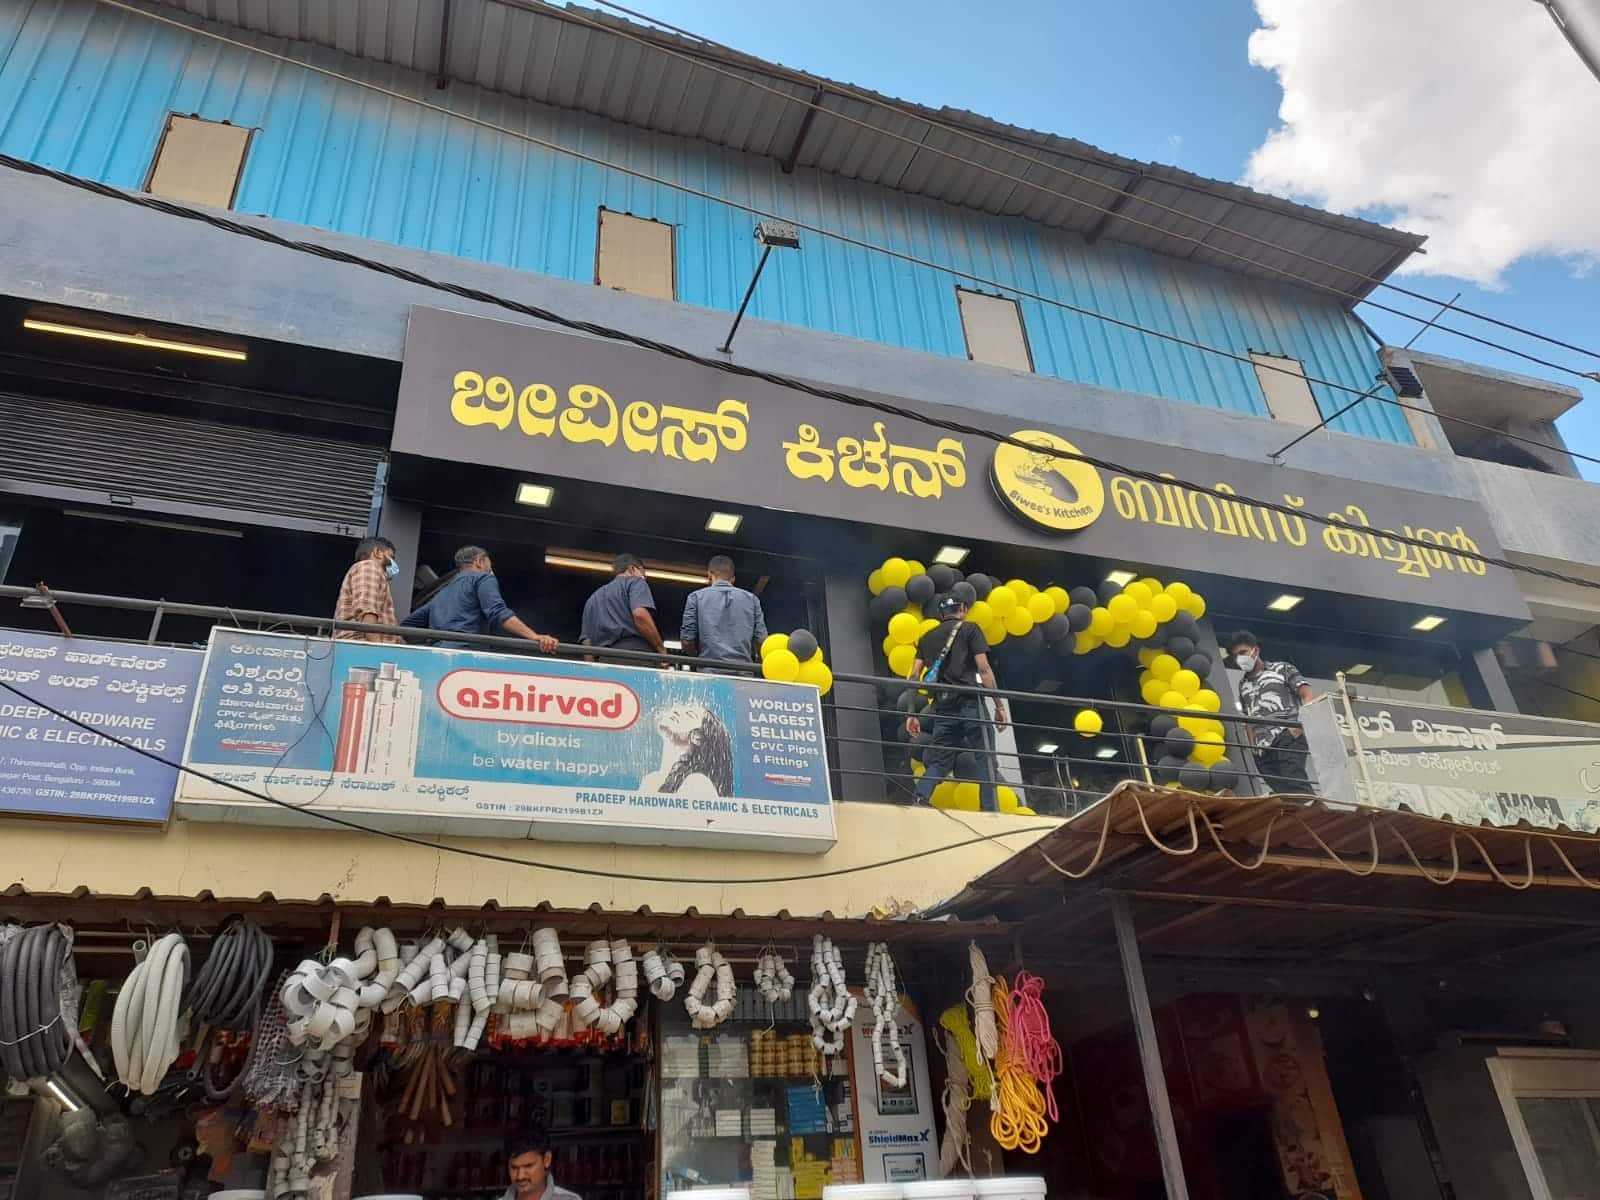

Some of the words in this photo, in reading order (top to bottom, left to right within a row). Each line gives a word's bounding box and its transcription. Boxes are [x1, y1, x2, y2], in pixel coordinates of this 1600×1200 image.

[1053, 504, 1094, 519] Kitchen
[456, 683, 622, 720] ashirvad
[749, 698, 815, 713] WORLD'S
[0, 704, 50, 720] DEEP
[216, 709, 246, 718] CPVC
[749, 712, 815, 727] LARGEST
[25, 727, 38, 740] &
[43, 729, 167, 751] ELECTRICALS
[497, 730, 522, 746] by
[522, 732, 582, 749] aliaxis
[751, 726, 817, 742] SELLING
[751, 741, 784, 752] CPVC
[788, 744, 818, 755] Pipes
[472, 753, 496, 768] be
[501, 758, 551, 771] water
[555, 758, 609, 777] happy
[752, 754, 761, 764] &
[764, 755, 809, 769] Fittings
[576, 792, 626, 805] PRADEEP
[629, 796, 689, 809] HARDWARE
[741, 803, 750, 813] &
[752, 804, 818, 818] ELECTRICALS
